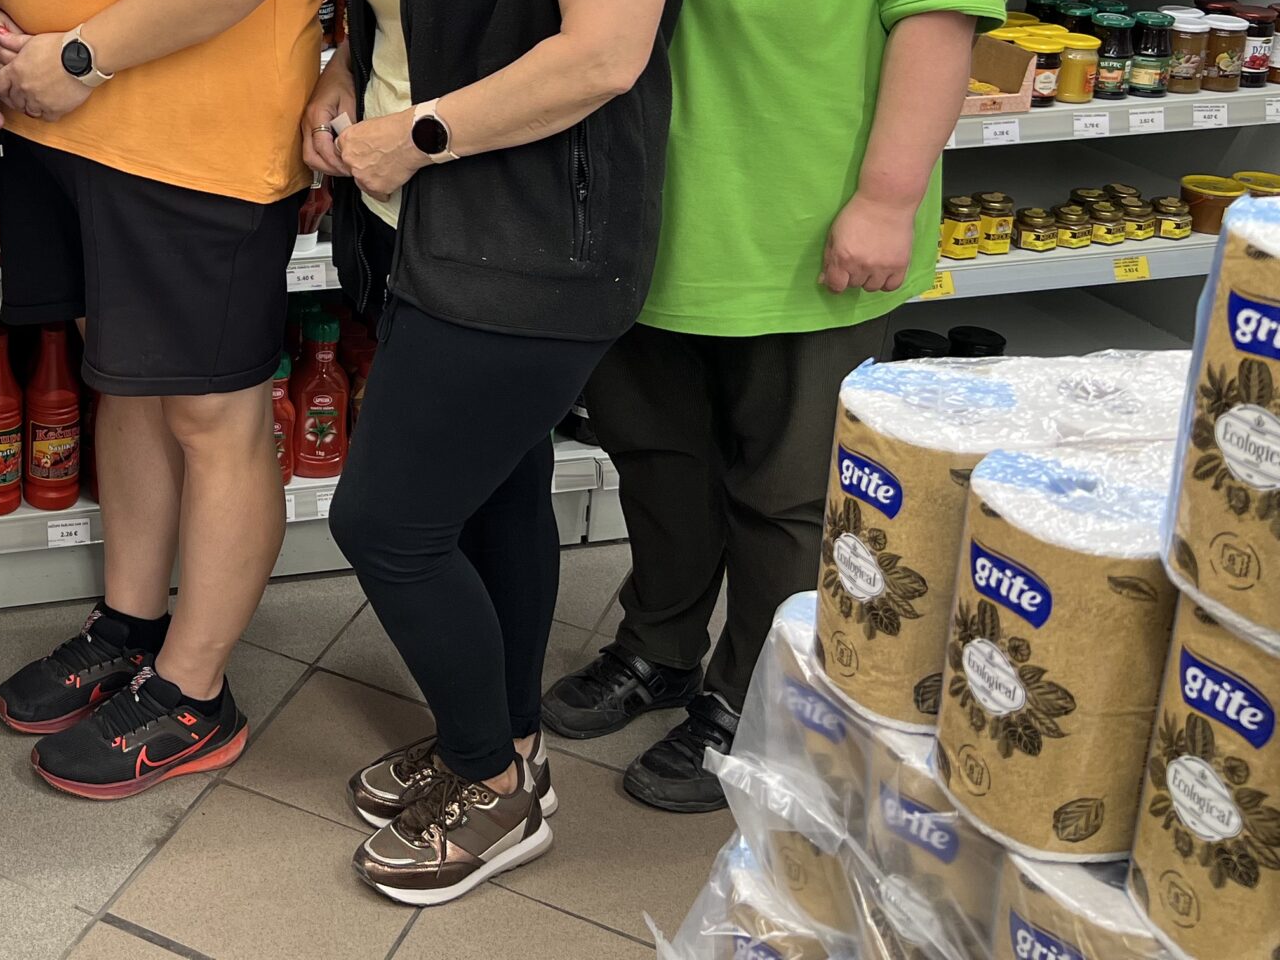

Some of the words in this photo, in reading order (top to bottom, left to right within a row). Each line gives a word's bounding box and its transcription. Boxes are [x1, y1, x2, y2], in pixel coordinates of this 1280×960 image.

[1222, 421, 1280, 464] Ecologic
[841, 458, 895, 504] grite
[836, 543, 878, 588] Ecological
[974, 555, 1044, 613] grite
[968, 651, 1017, 702] Ecological
[1184, 665, 1265, 731] grite
[1171, 768, 1233, 827] Ecological
